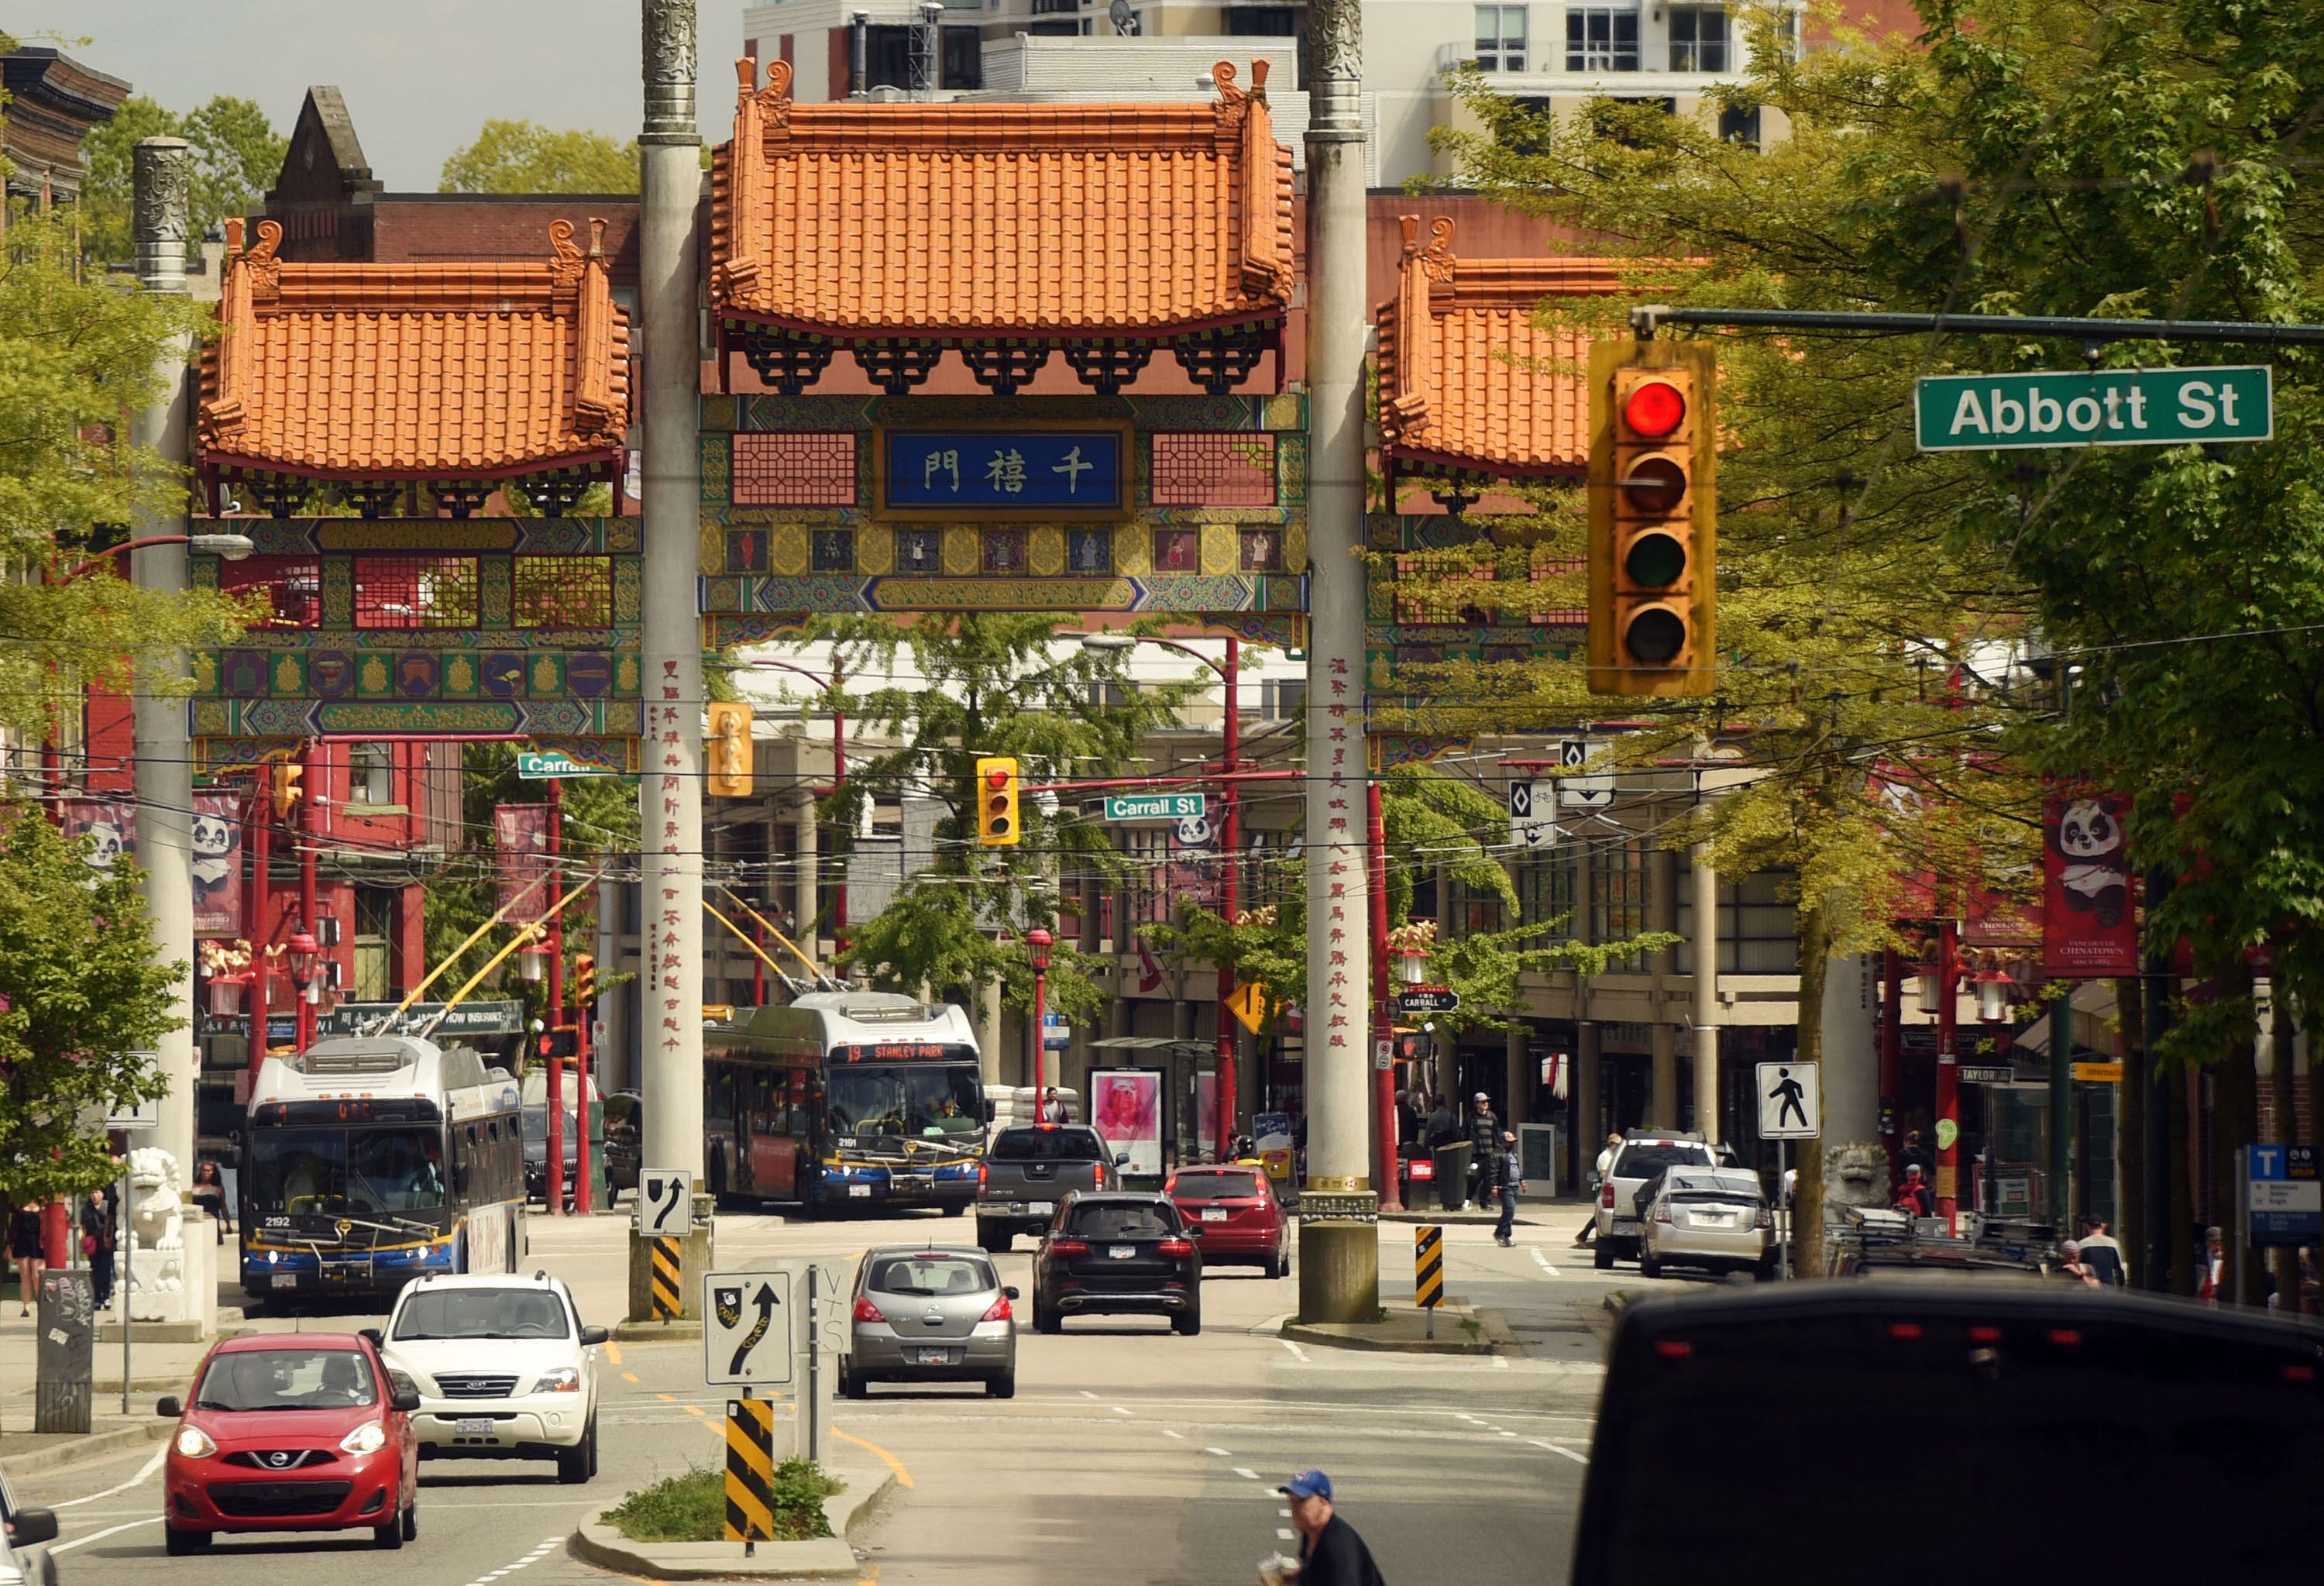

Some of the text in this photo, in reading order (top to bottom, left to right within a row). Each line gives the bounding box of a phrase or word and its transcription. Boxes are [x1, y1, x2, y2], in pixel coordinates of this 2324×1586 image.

[1949, 381, 2240, 435] Abbott St
[1113, 797, 1196, 816] Carrall St
[467, 1011, 504, 1022] INSURANCE
[847, 1045, 944, 1063] 19 STANLEY PARK
[1963, 1069, 1995, 1081] TAYLOR
[838, 1137, 857, 1147] 2191
[265, 1216, 290, 1226] 2192
